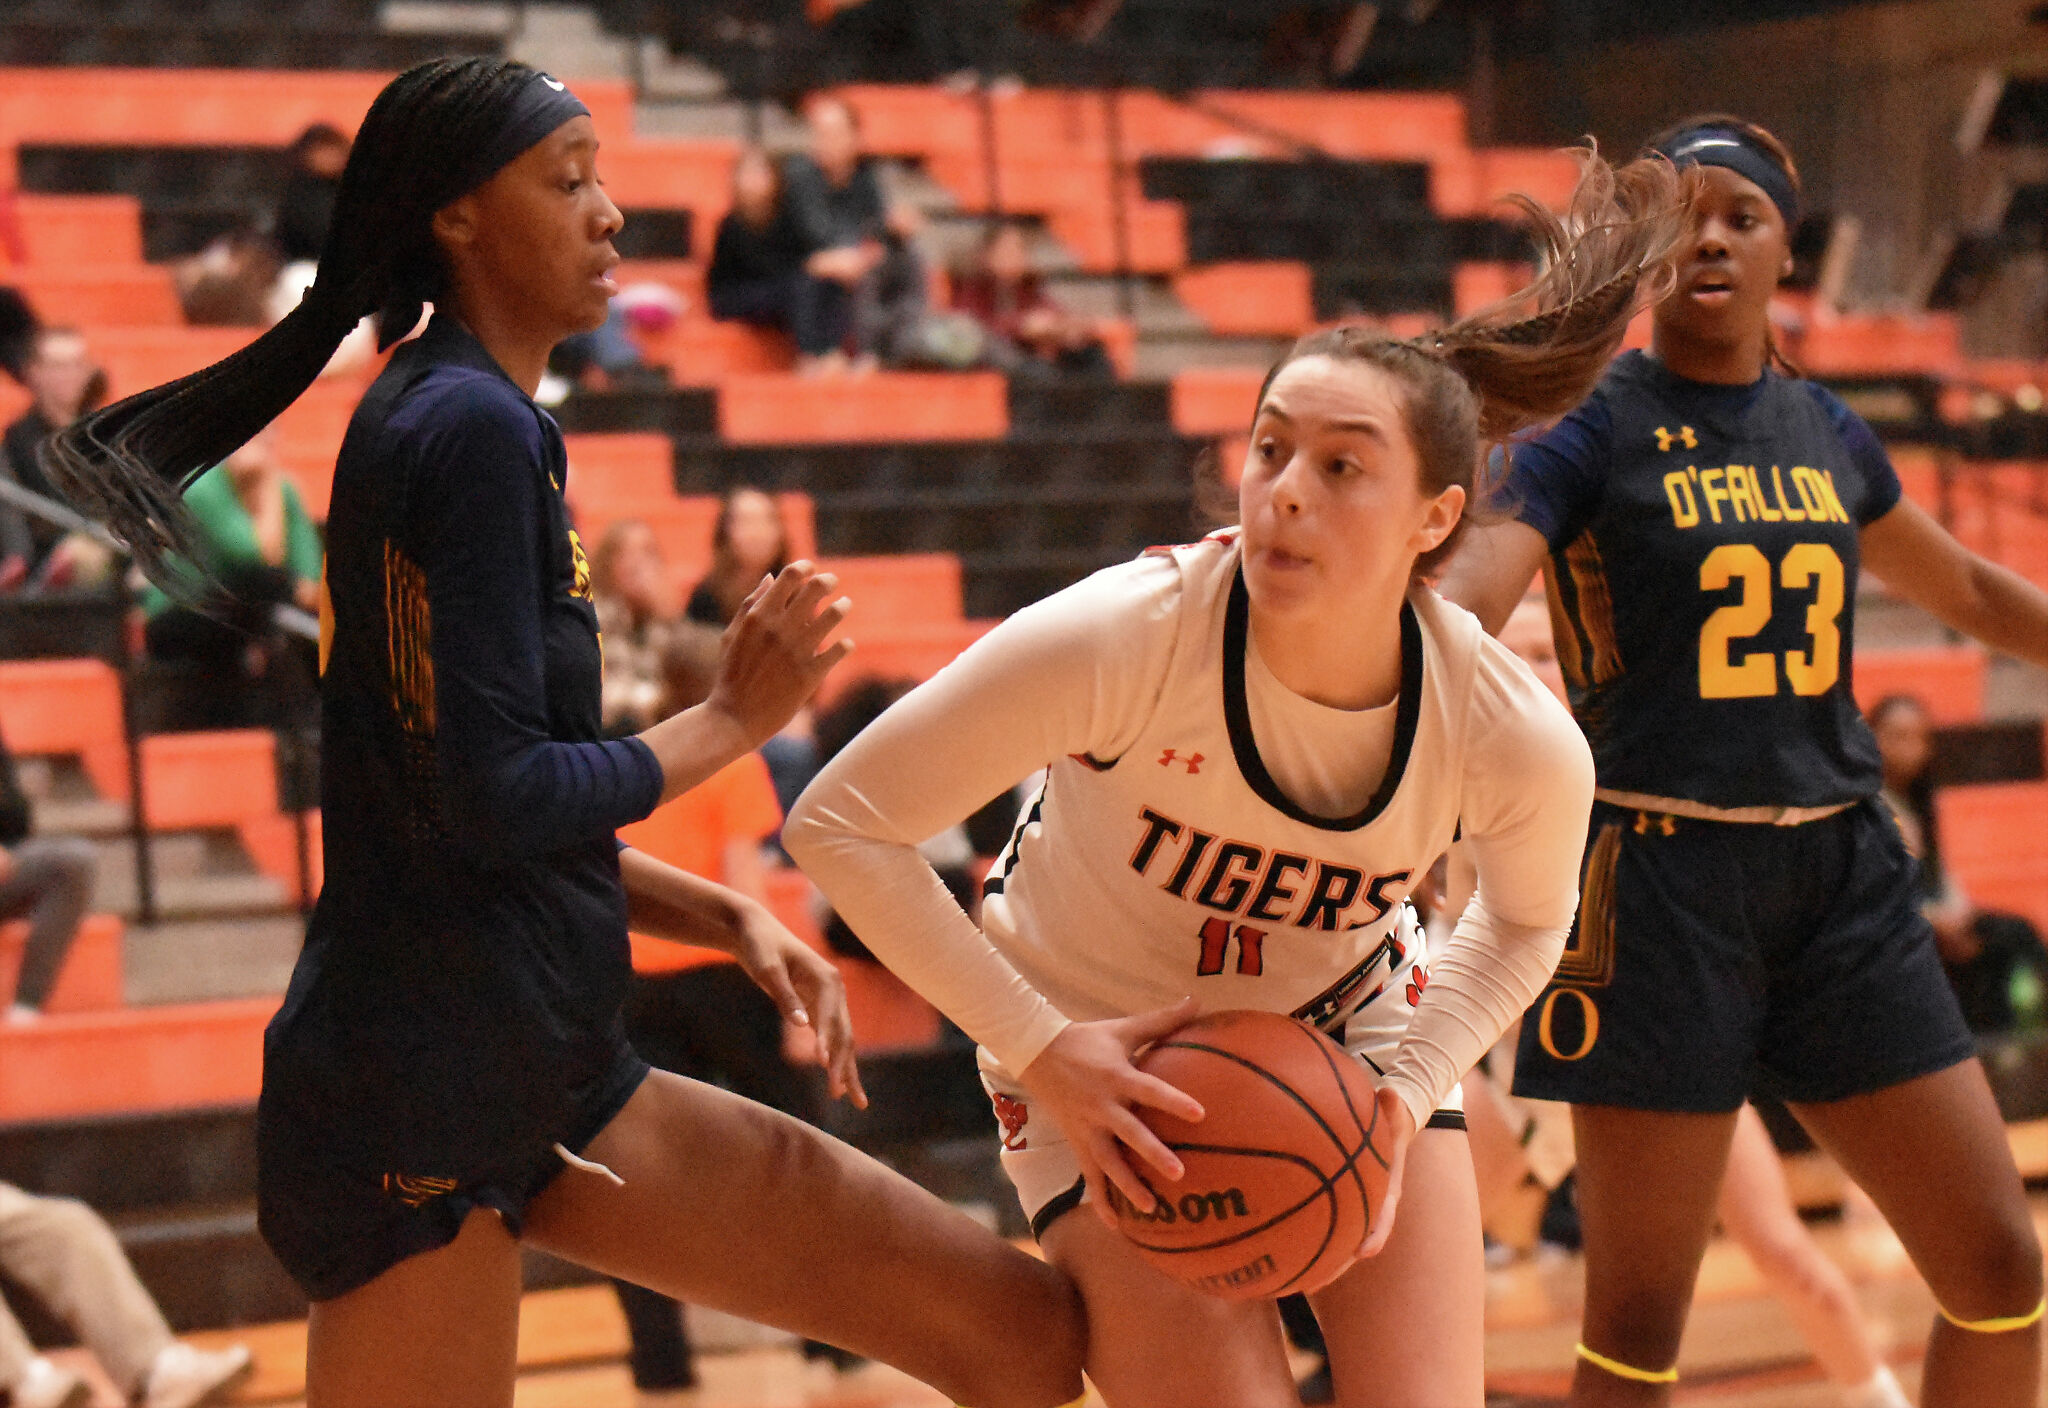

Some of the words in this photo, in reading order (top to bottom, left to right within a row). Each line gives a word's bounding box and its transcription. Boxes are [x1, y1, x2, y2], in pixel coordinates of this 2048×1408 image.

[1663, 465, 1849, 529] O'FALLON
[1699, 543, 1844, 699] 23
[1128, 804, 1414, 931] TIGERS
[1196, 916, 1268, 976] 11
[1539, 988, 1599, 1061] O
